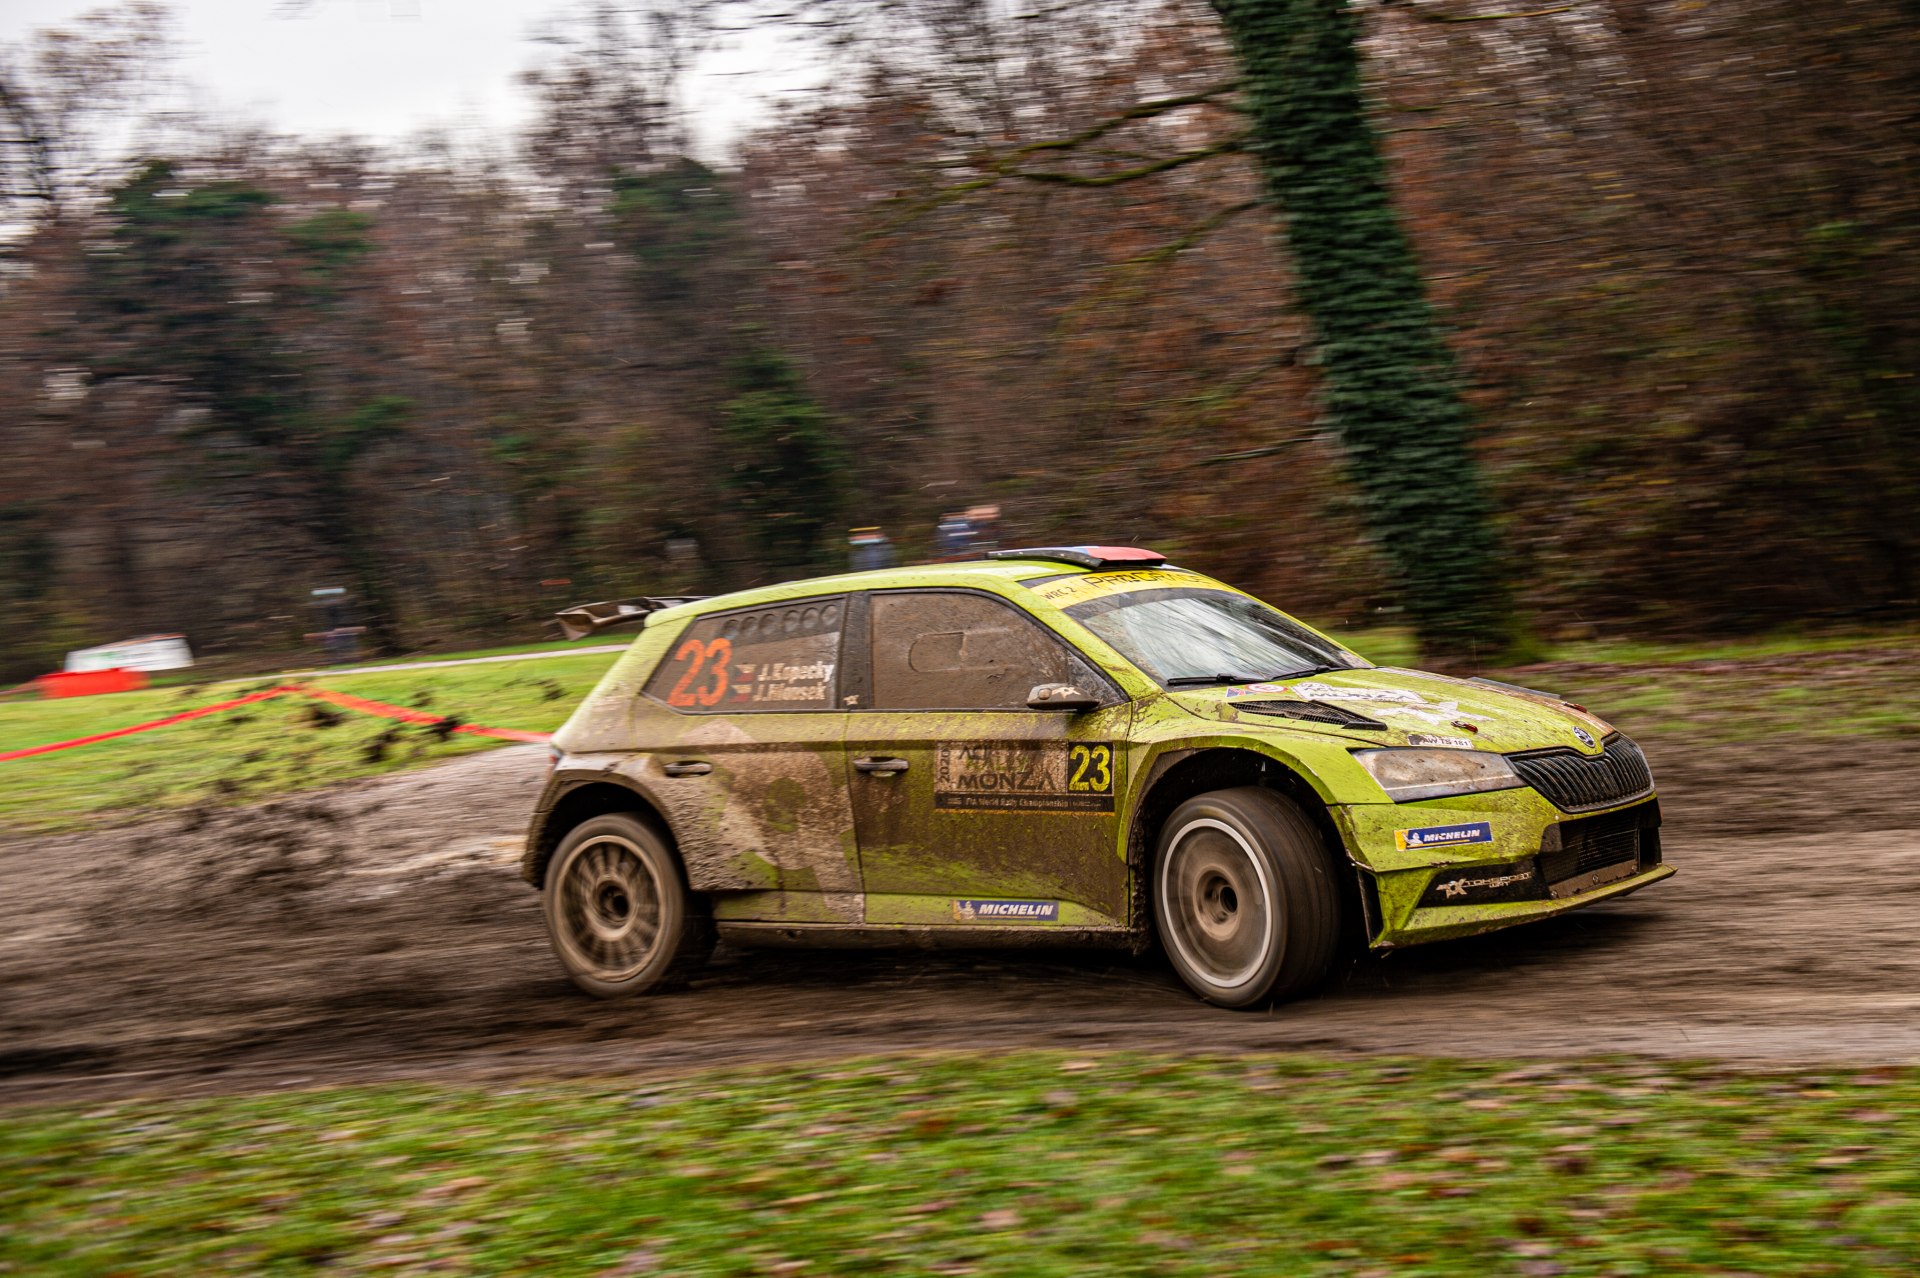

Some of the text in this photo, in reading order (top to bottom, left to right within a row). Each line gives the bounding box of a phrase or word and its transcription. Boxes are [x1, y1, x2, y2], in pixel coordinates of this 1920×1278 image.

[667, 637, 733, 707] 23
[938, 745, 951, 784] 2020
[1069, 745, 1112, 792] 23
[957, 770, 1057, 790] MONZA
[1423, 828, 1481, 842] MICHELIN
[978, 903, 1054, 916] MICHELIN
